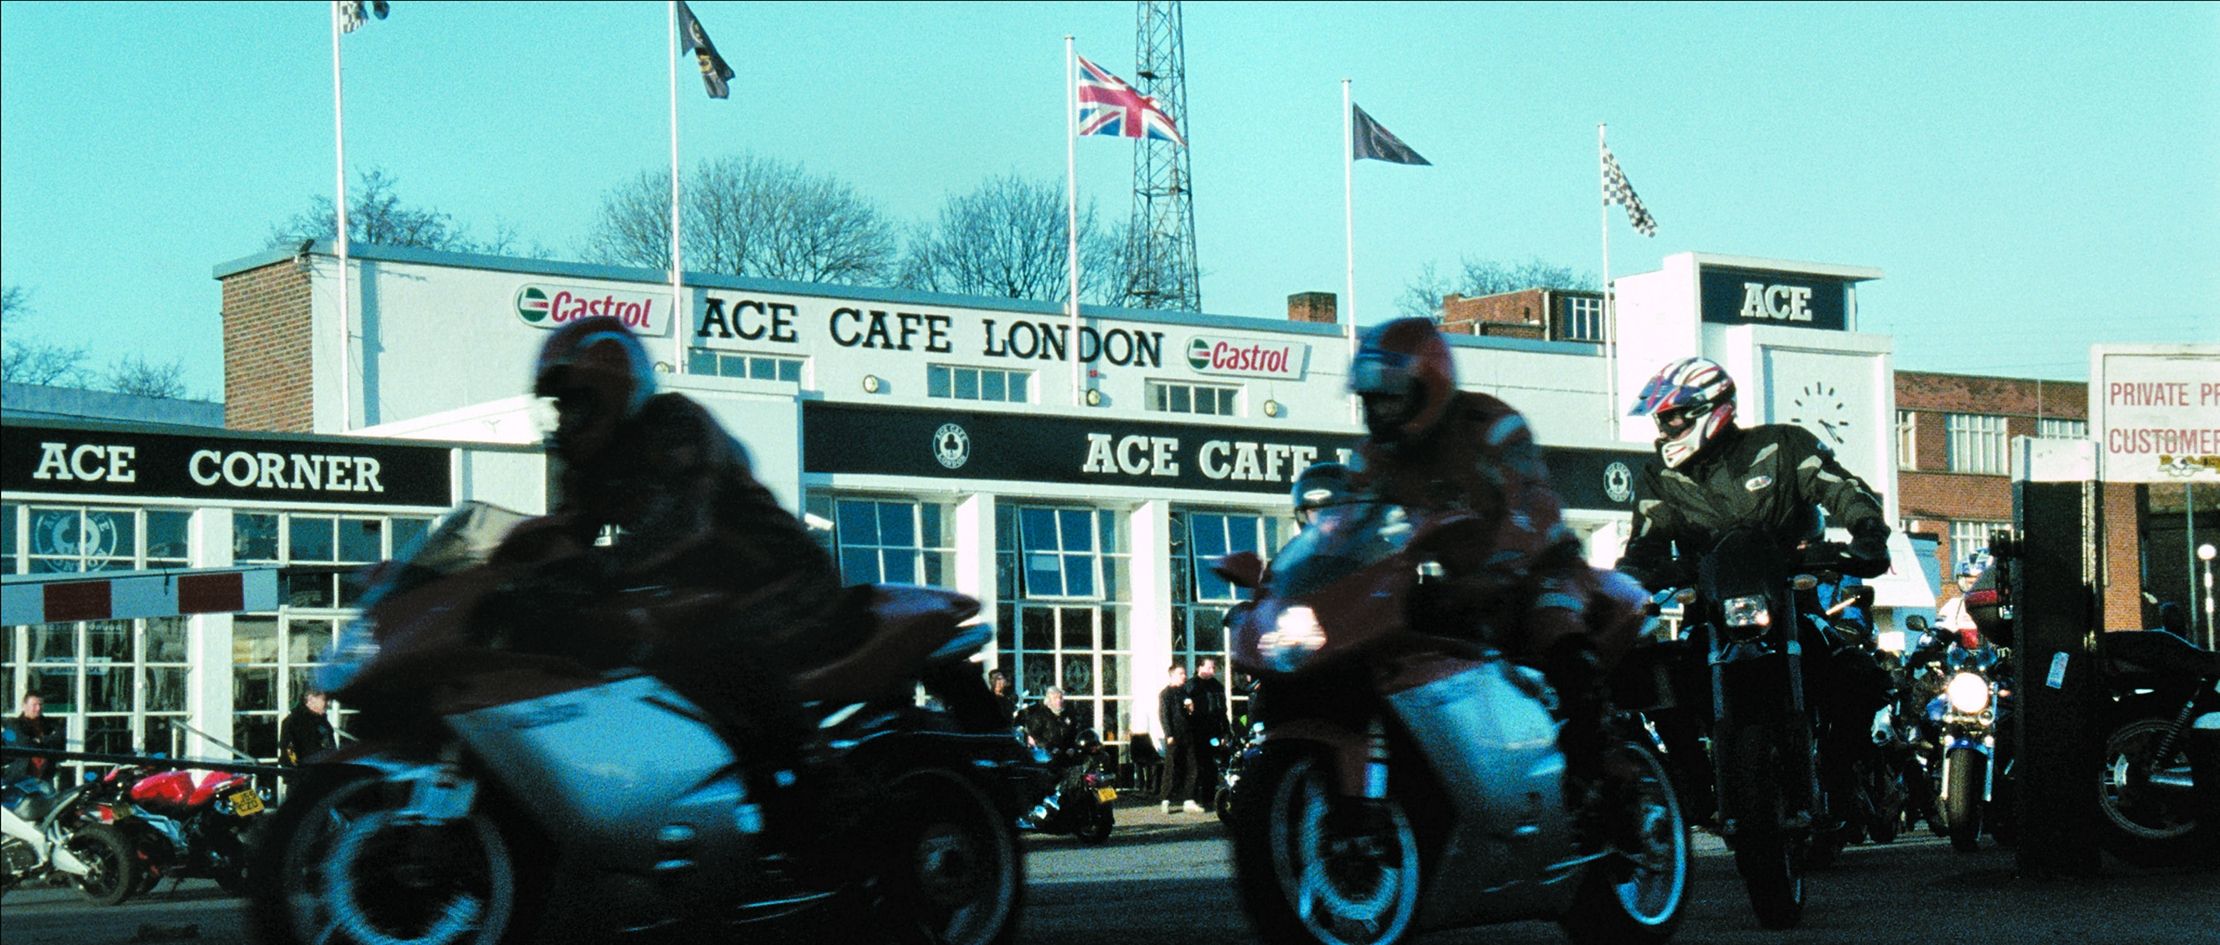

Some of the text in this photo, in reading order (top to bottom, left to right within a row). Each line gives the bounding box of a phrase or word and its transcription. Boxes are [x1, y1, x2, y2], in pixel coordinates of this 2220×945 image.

[551, 291, 652, 328] Castrol
[1740, 282, 1812, 321] ACE
[698, 298, 1165, 369] ACE CAFE LONDON
[1211, 340, 1290, 373] Castrol
[2110, 382, 2190, 407] PRIVATE
[34, 443, 384, 494] ACE CORNER
[1083, 433, 1180, 477] ACE
[1199, 439, 1318, 484] CAFE
